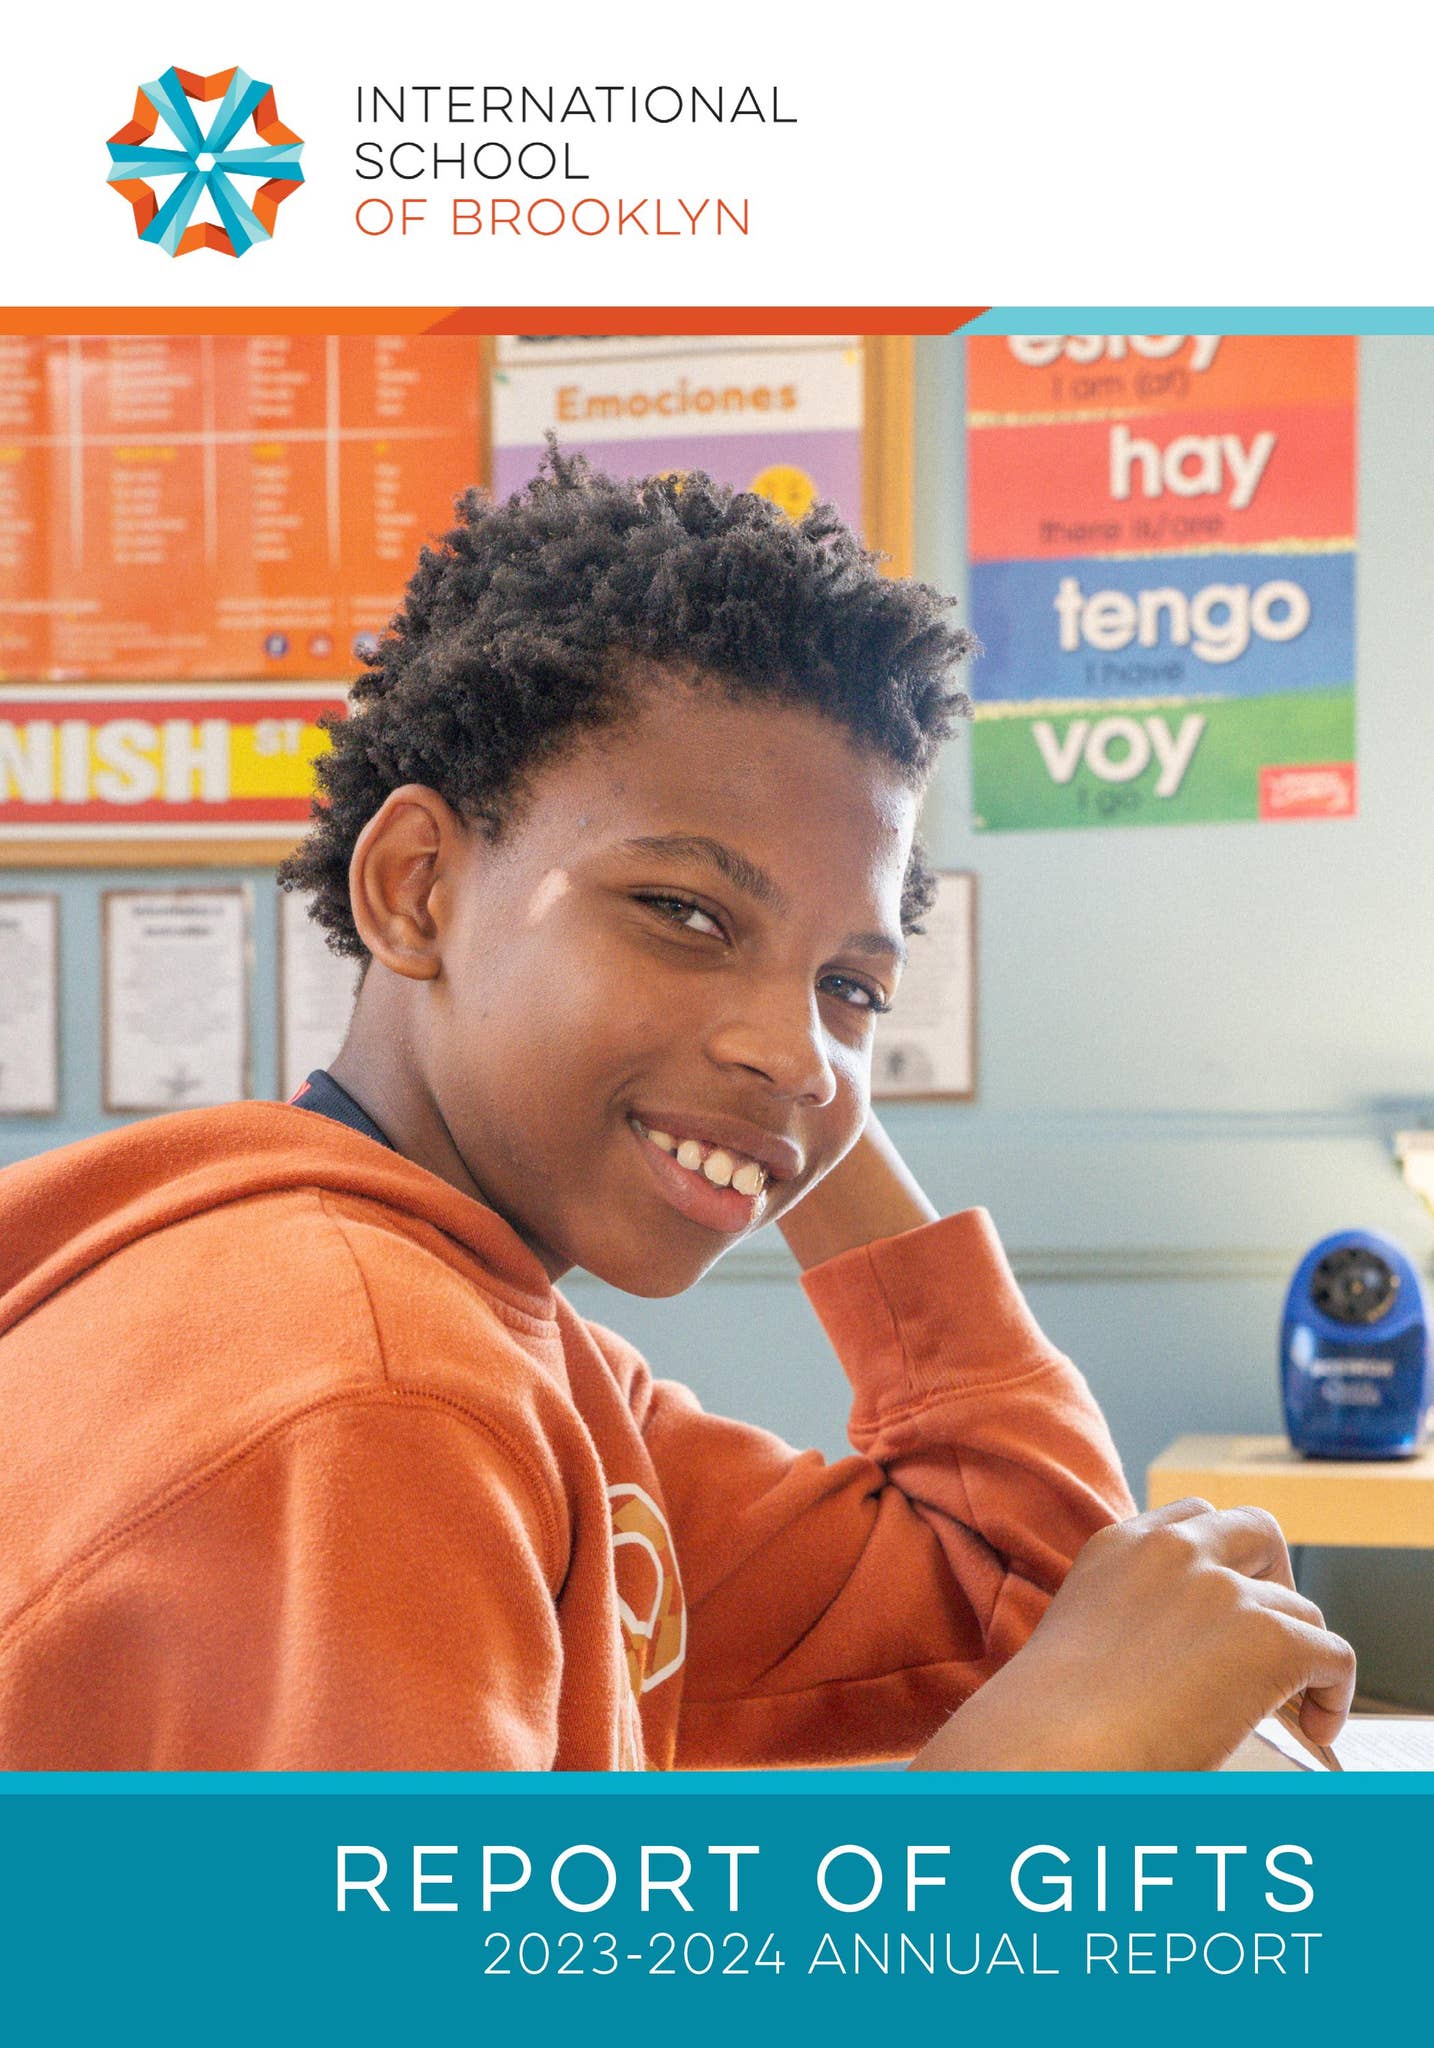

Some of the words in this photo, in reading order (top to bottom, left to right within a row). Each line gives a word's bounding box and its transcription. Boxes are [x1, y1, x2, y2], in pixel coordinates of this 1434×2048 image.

[555, 377, 798, 423] Emociones
[1110, 424, 1276, 509] hay
[1053, 577, 1311, 663] tengo
[1101, 659, 1185, 686] have
[0, 718, 230, 805] NISH
[1031, 713, 1206, 797] voy
